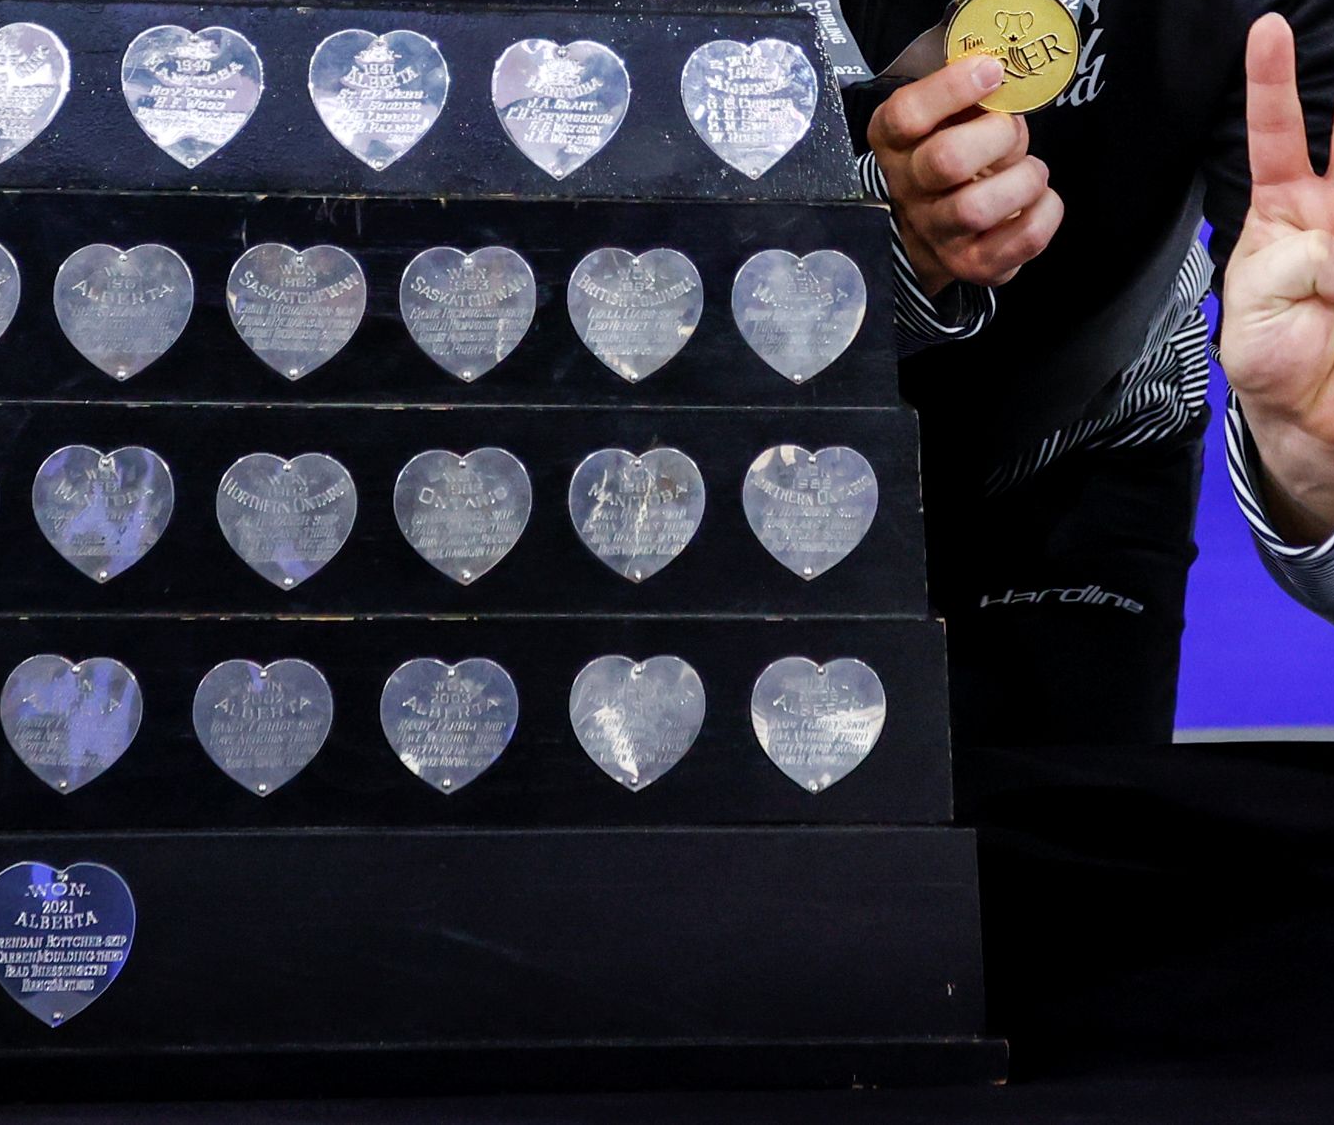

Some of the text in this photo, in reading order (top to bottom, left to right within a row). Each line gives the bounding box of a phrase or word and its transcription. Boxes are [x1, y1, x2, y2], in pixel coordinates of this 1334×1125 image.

[814, 0, 847, 45] CURLING
[957, 32, 985, 54] Tim
[239, 270, 360, 305] SASKATCHEWAN
[980, 584, 1144, 614] Hardline
[14, 909, 99, 931] ALBERTA
[41, 900, 75, 914] 2021
